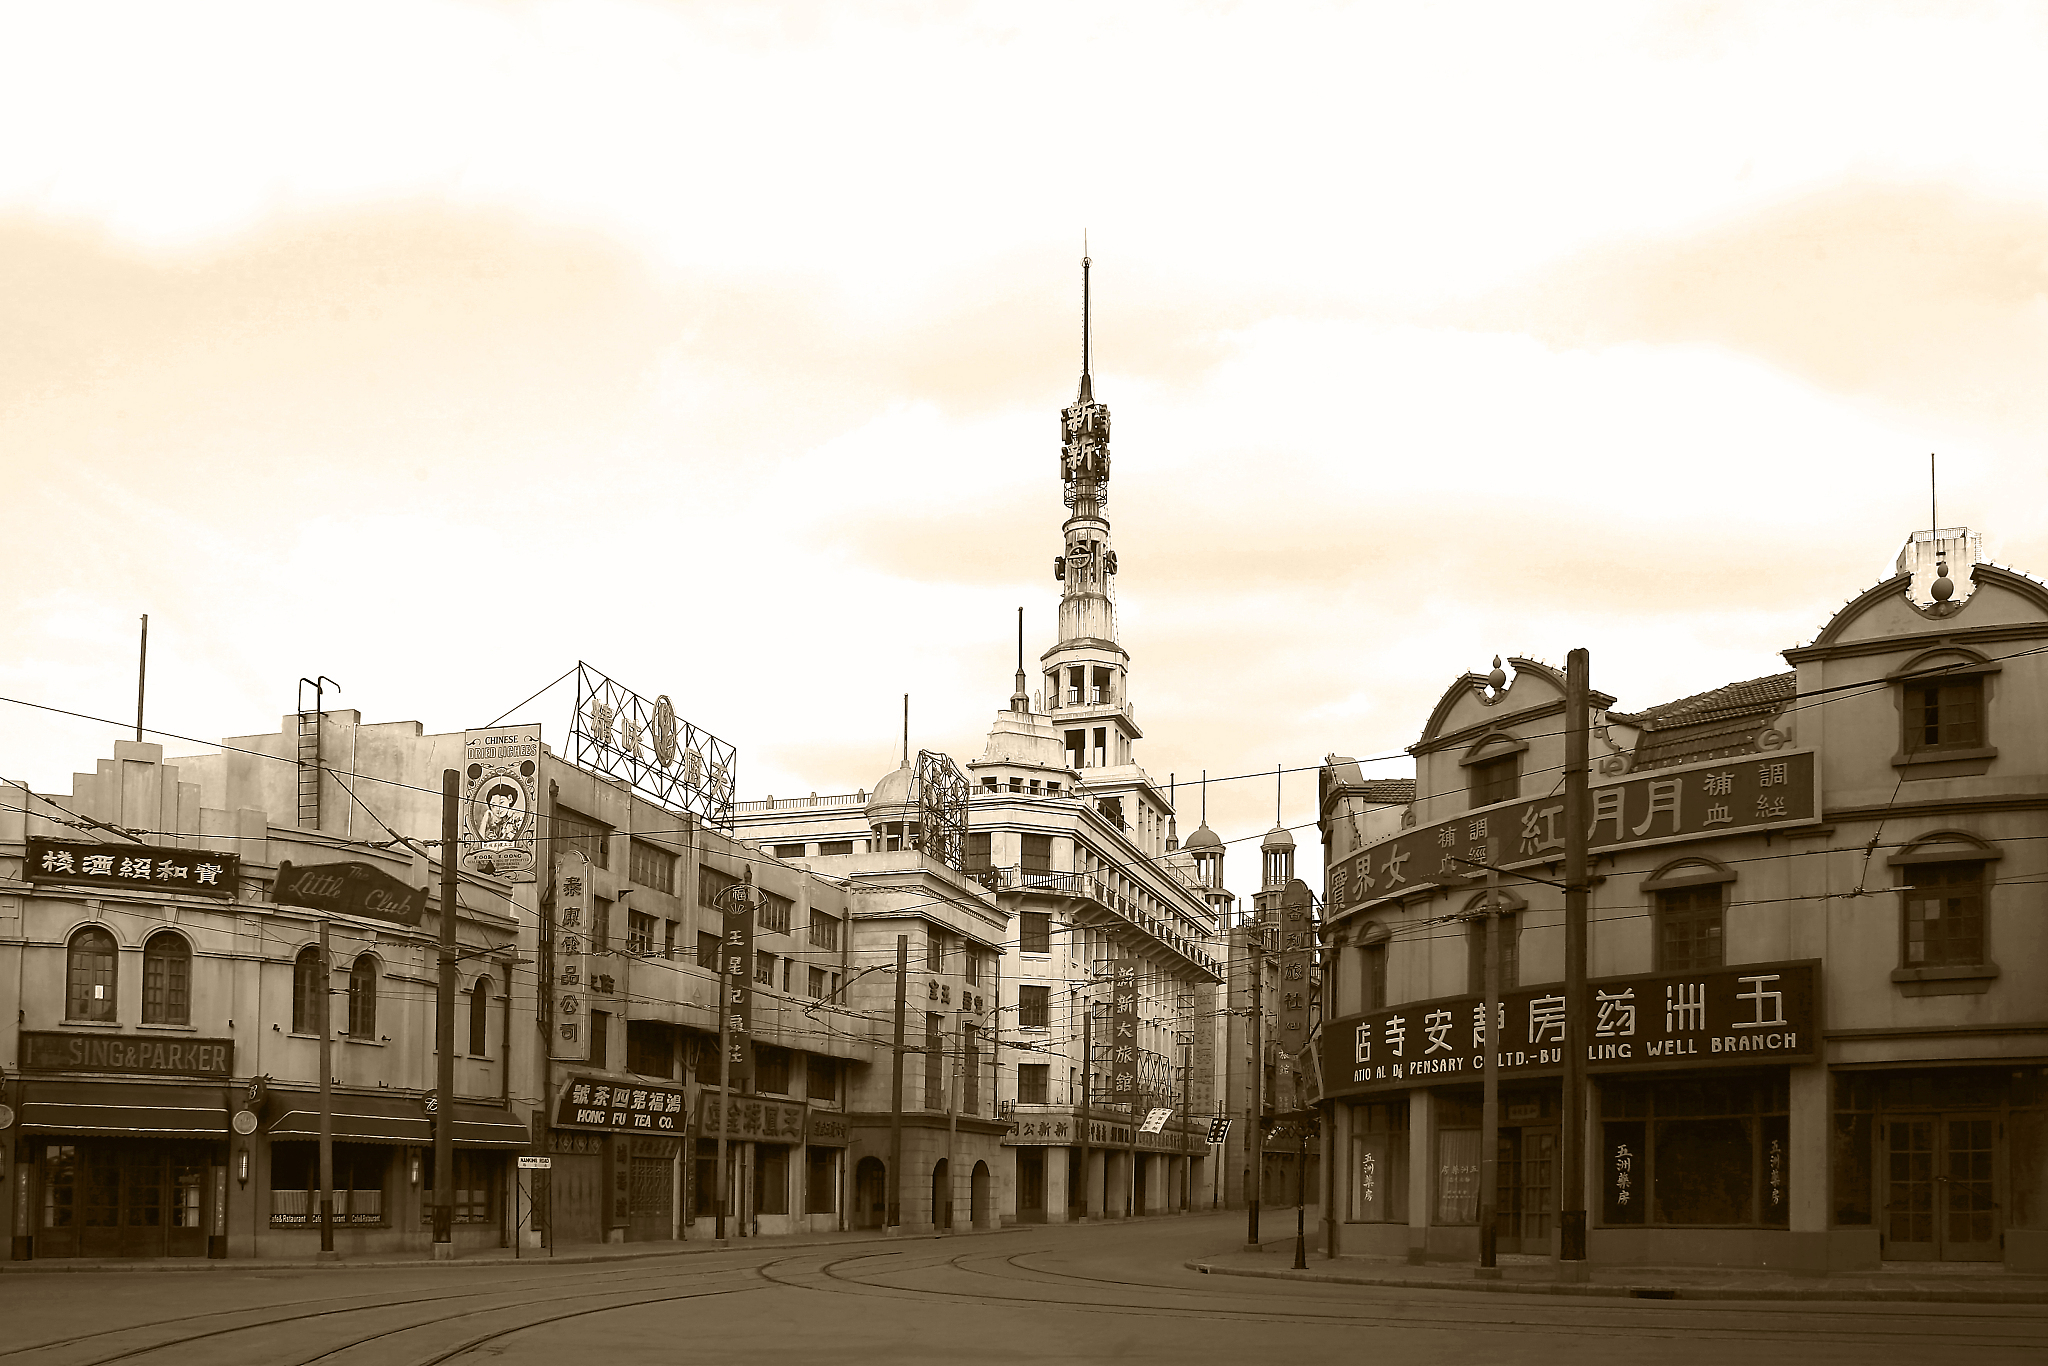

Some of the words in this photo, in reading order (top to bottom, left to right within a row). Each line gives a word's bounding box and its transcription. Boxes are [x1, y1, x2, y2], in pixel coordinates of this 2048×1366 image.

[485, 735, 519, 745] CHINESE
[468, 747, 496, 759] DRIED
[350, 865, 370, 880] The
[288, 871, 344, 899] Little
[365, 889, 411, 915] Club
[69, 1038, 227, 1072] SING&PARKER
[1410, 1057, 1464, 1075] PENSARY
[1473, 1054, 1486, 1069] C
[1646, 1038, 1698, 1057] WELL
[1711, 1032, 1797, 1053] BRANCH
[576, 1109, 606, 1124] HONG
[612, 1112, 627, 1126] FU
[634, 1114, 651, 1127] TEA
[658, 1116, 674, 1129] CO.
